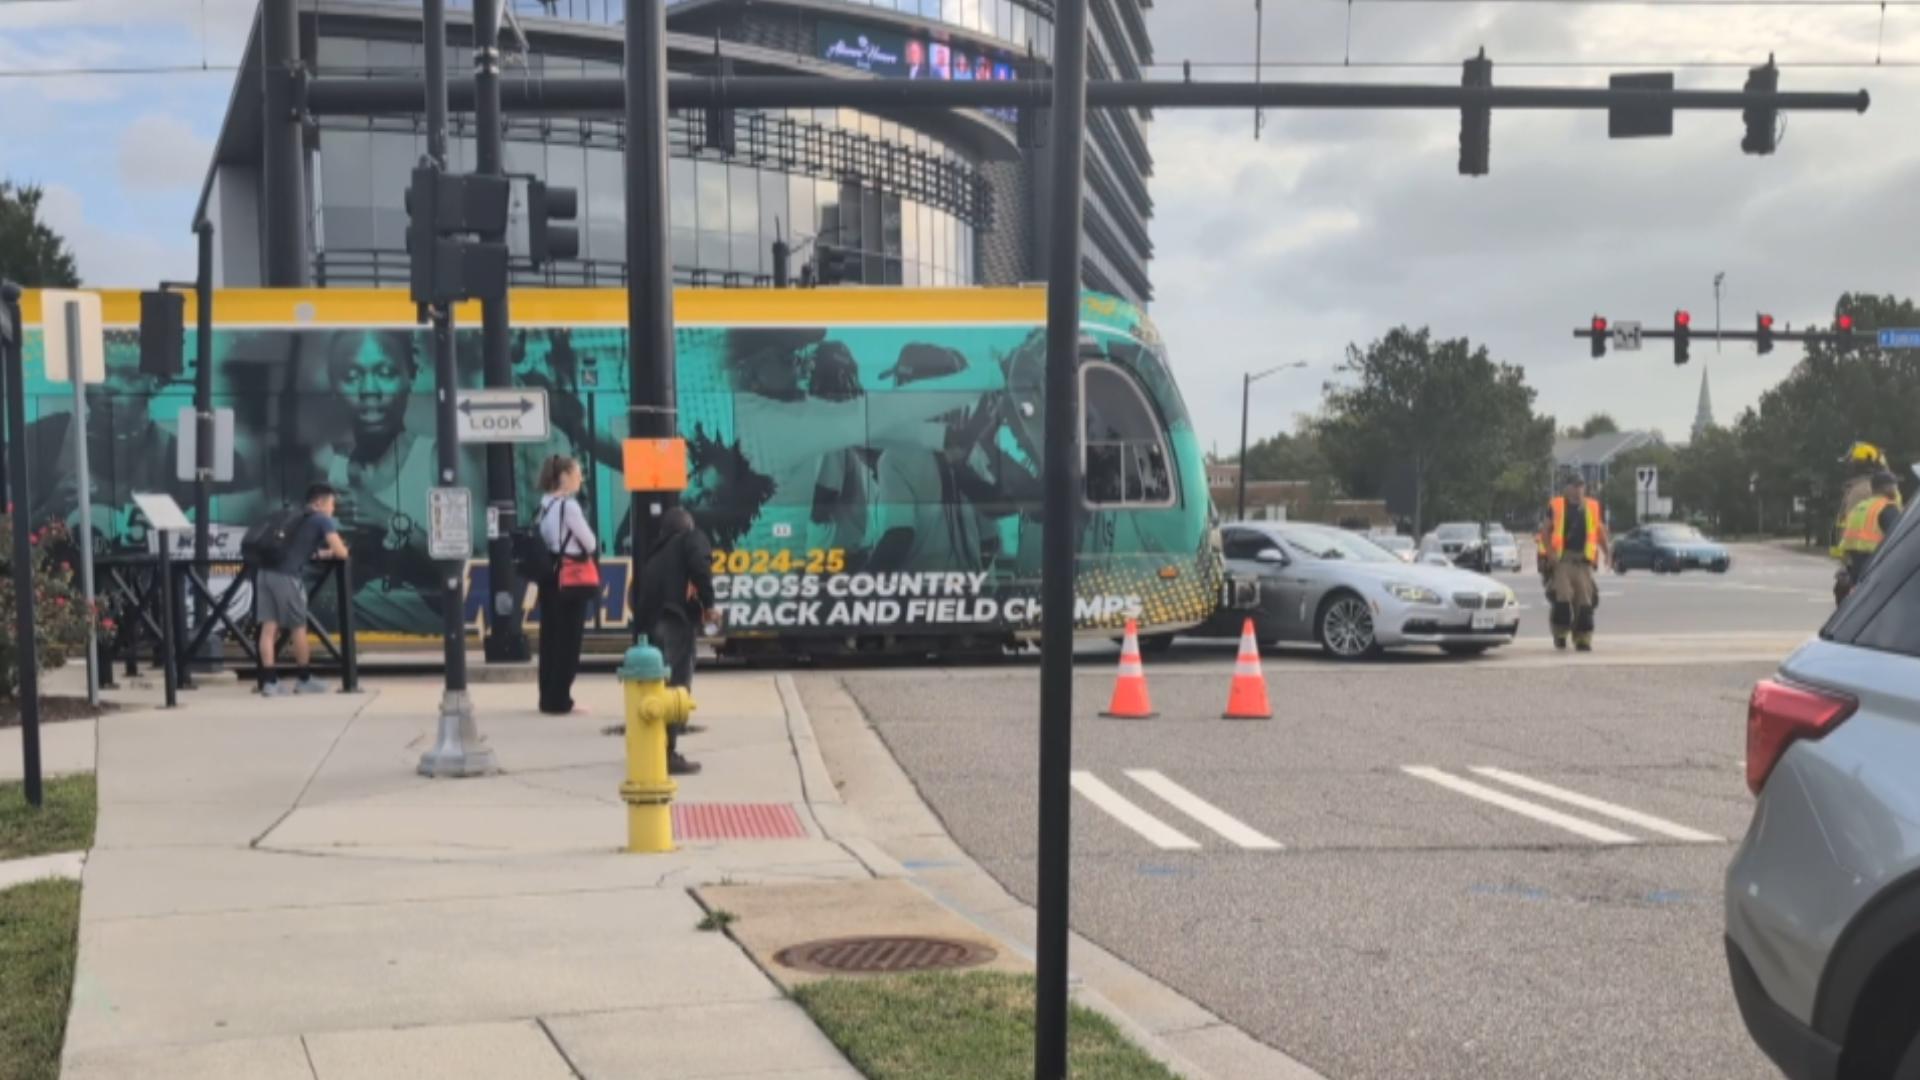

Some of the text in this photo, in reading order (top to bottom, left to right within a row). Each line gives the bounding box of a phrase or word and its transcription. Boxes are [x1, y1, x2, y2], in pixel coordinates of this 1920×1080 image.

[469, 415, 522, 431] LOOK
[711, 549, 845, 574] 2024-25
[711, 571, 988, 599] CROSS COUNTRY
[713, 595, 1142, 626] TRACK AND FIELD CHMPS
